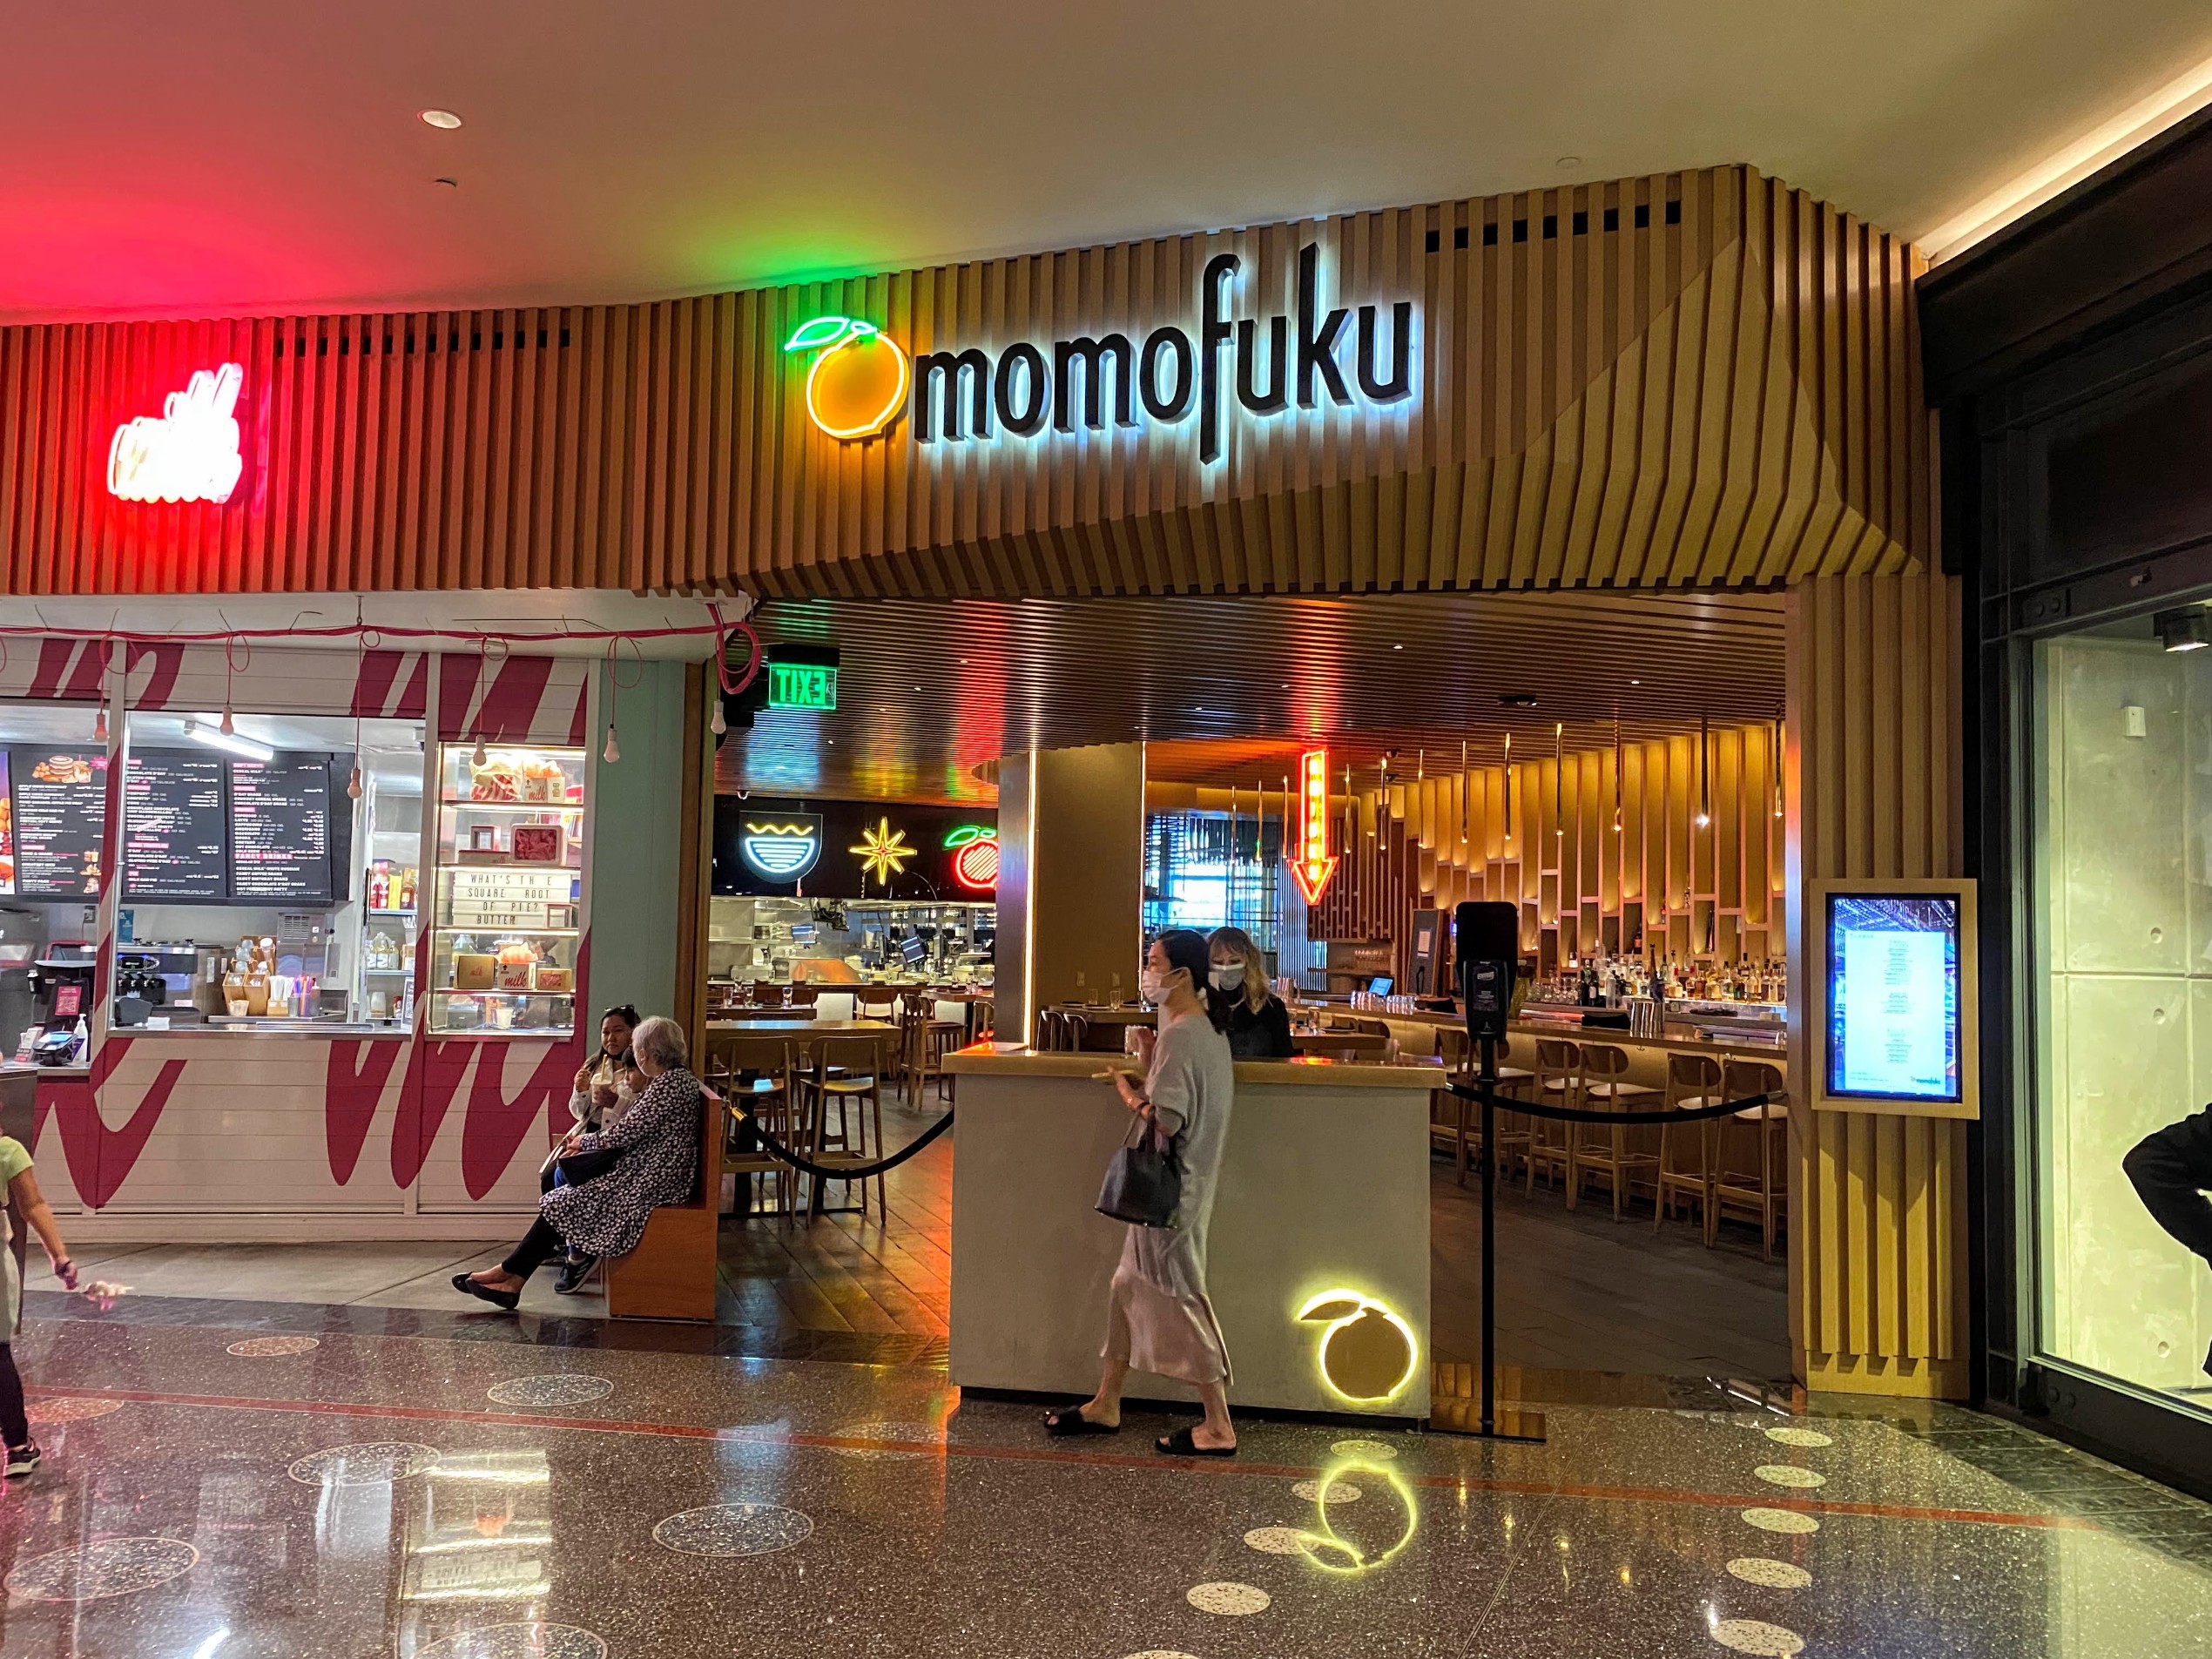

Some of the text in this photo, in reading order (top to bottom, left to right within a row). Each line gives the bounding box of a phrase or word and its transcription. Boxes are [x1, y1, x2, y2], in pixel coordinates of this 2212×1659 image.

[914, 242, 1413, 464] momofuku
[529, 786, 545, 800] milk
[471, 873, 510, 885] WHAT'S
[469, 888, 550, 899] SQUARE ROOT
[482, 902, 538, 912] OF PIE?
[505, 971, 528, 988] milk
